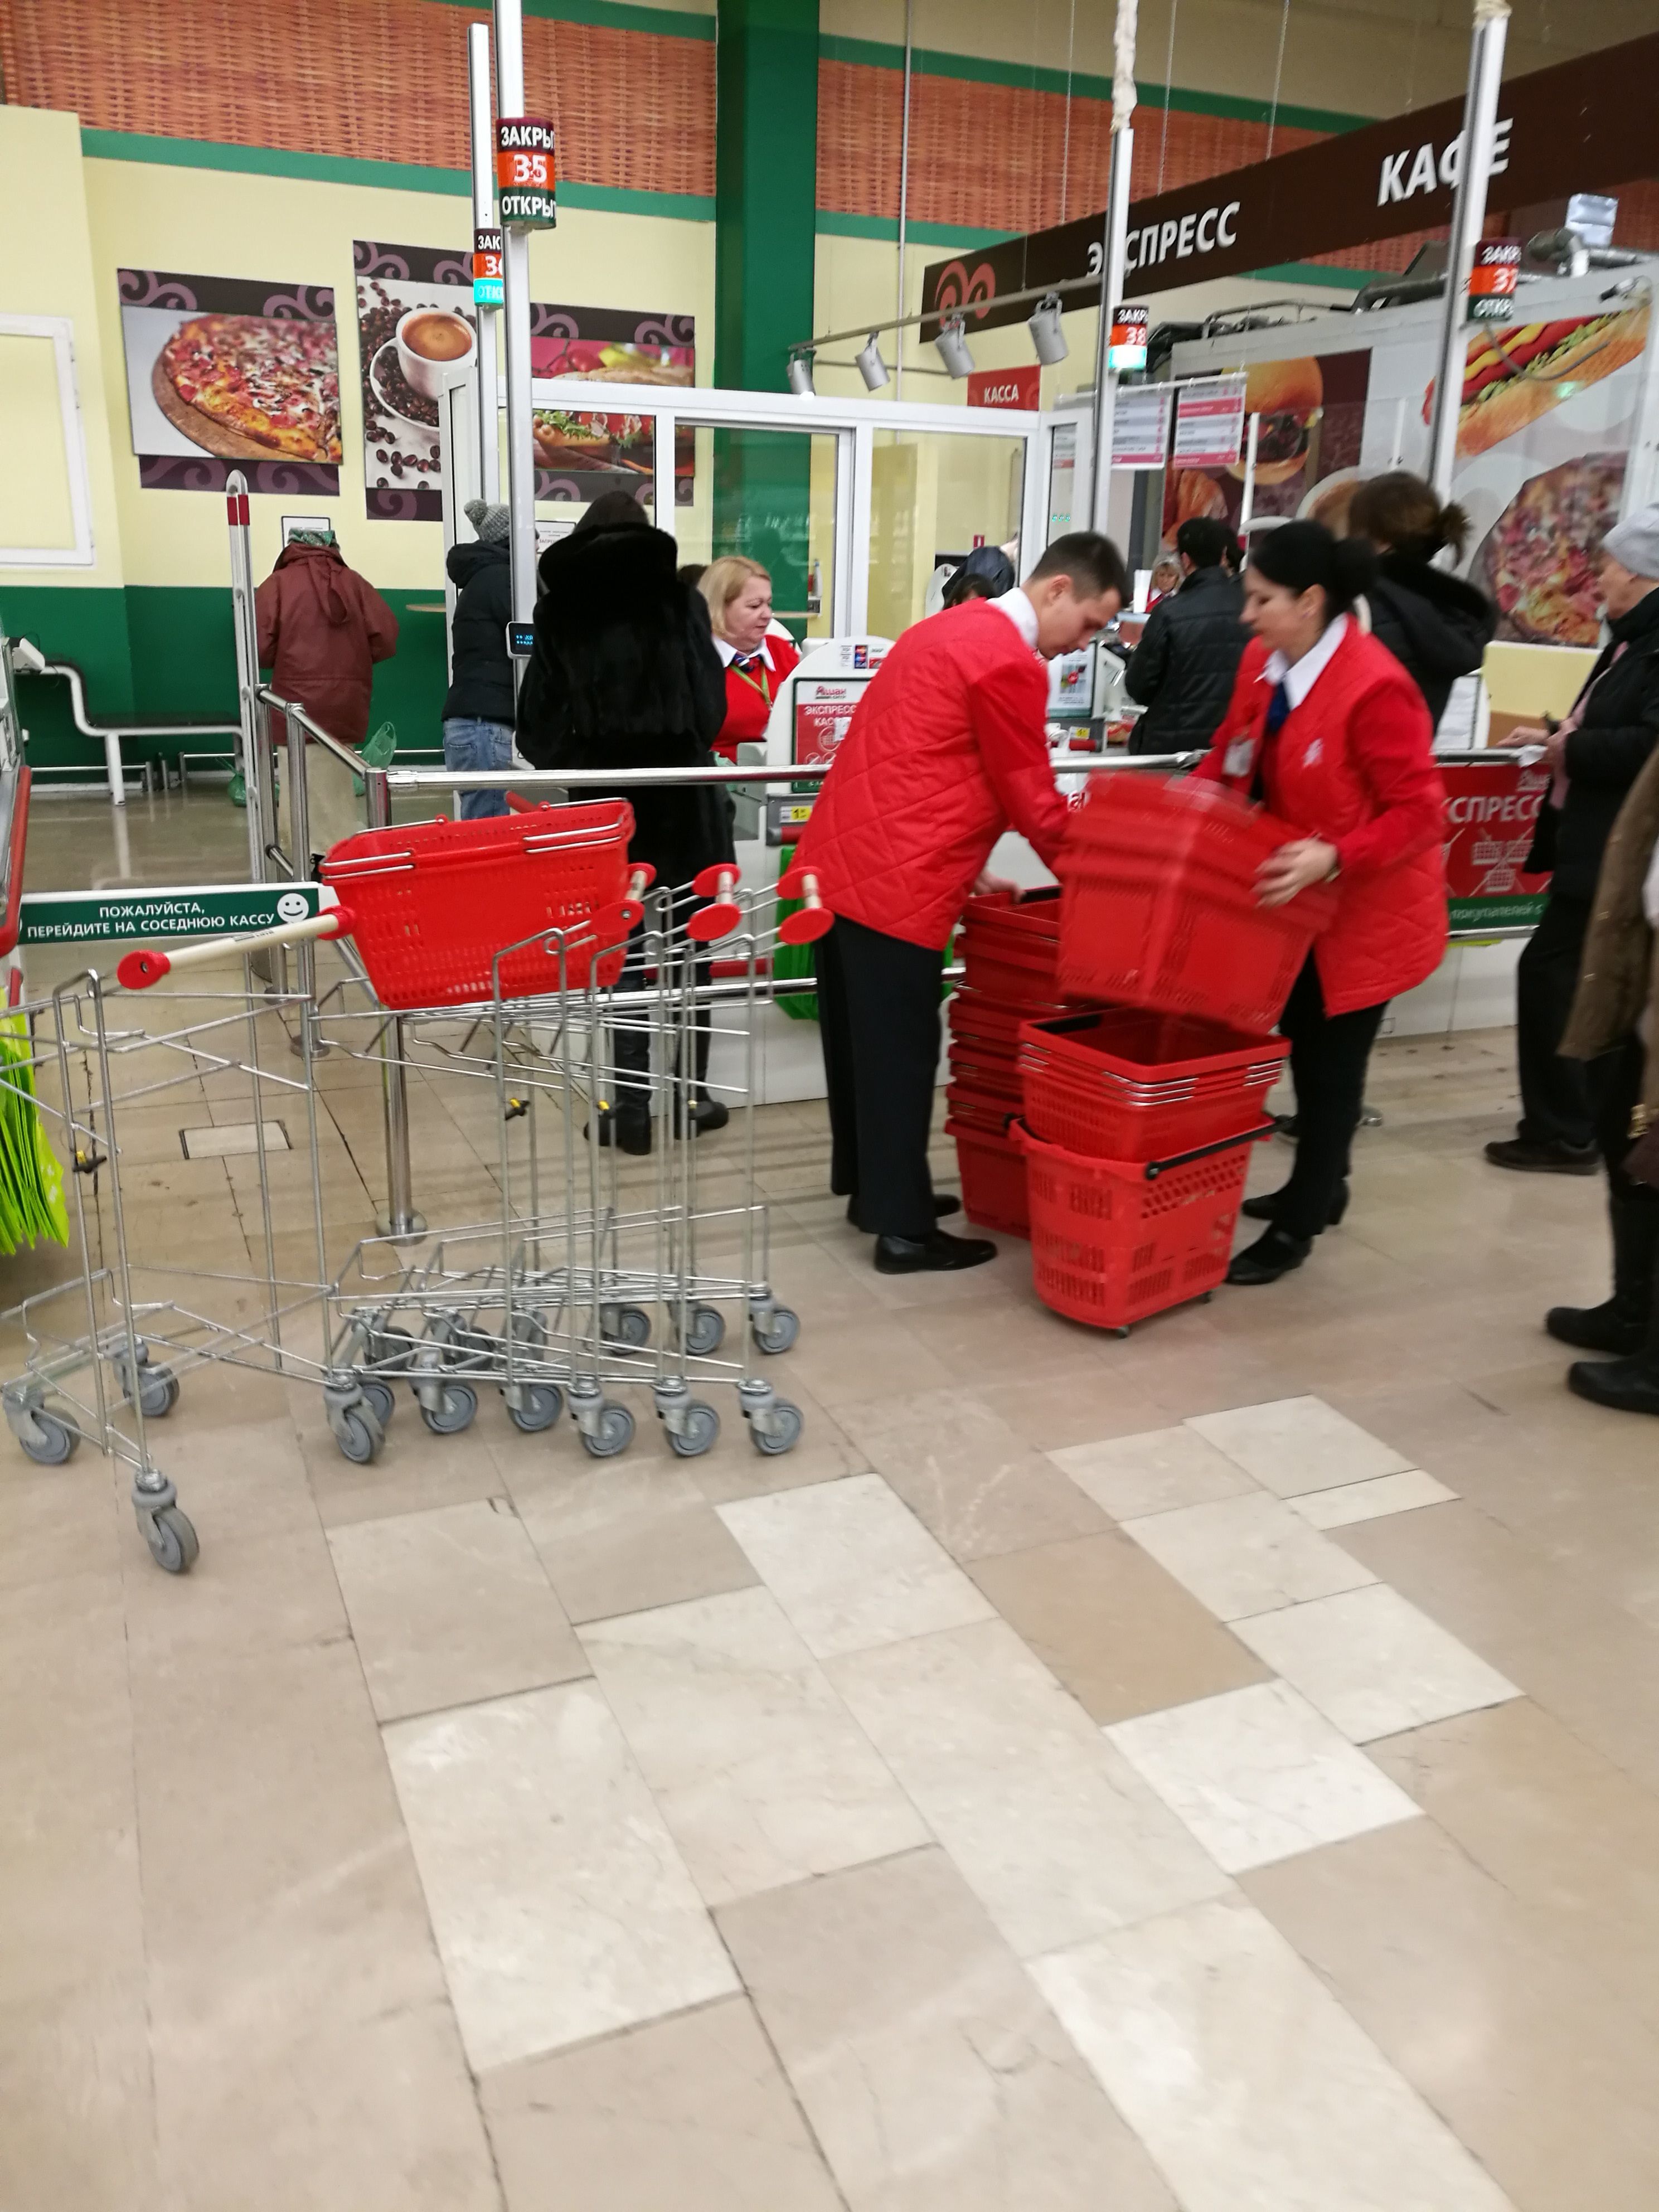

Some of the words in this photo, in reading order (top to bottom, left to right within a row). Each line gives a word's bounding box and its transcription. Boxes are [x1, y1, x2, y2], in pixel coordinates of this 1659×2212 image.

[501, 125, 555, 149] ЗАКРЫ
[513, 154, 547, 183] 35
[1087, 201, 1241, 275] ЭСПРЕСС
[1125, 327, 1147, 345] 38
[984, 384, 1020, 404] КАССА
[804, 705, 857, 715] ЭКСПРЕСС
[1441, 795, 1545, 823] СПРЕСС
[99, 901, 205, 919] ПОЖАЛУЙСТА,
[27, 922, 110, 938] ПЕРЕЙДИТЕ
[115, 921, 135, 934] НА
[140, 916, 225, 932] СОСЕДНЮЮ
[230, 913, 275, 926] КАССУ
